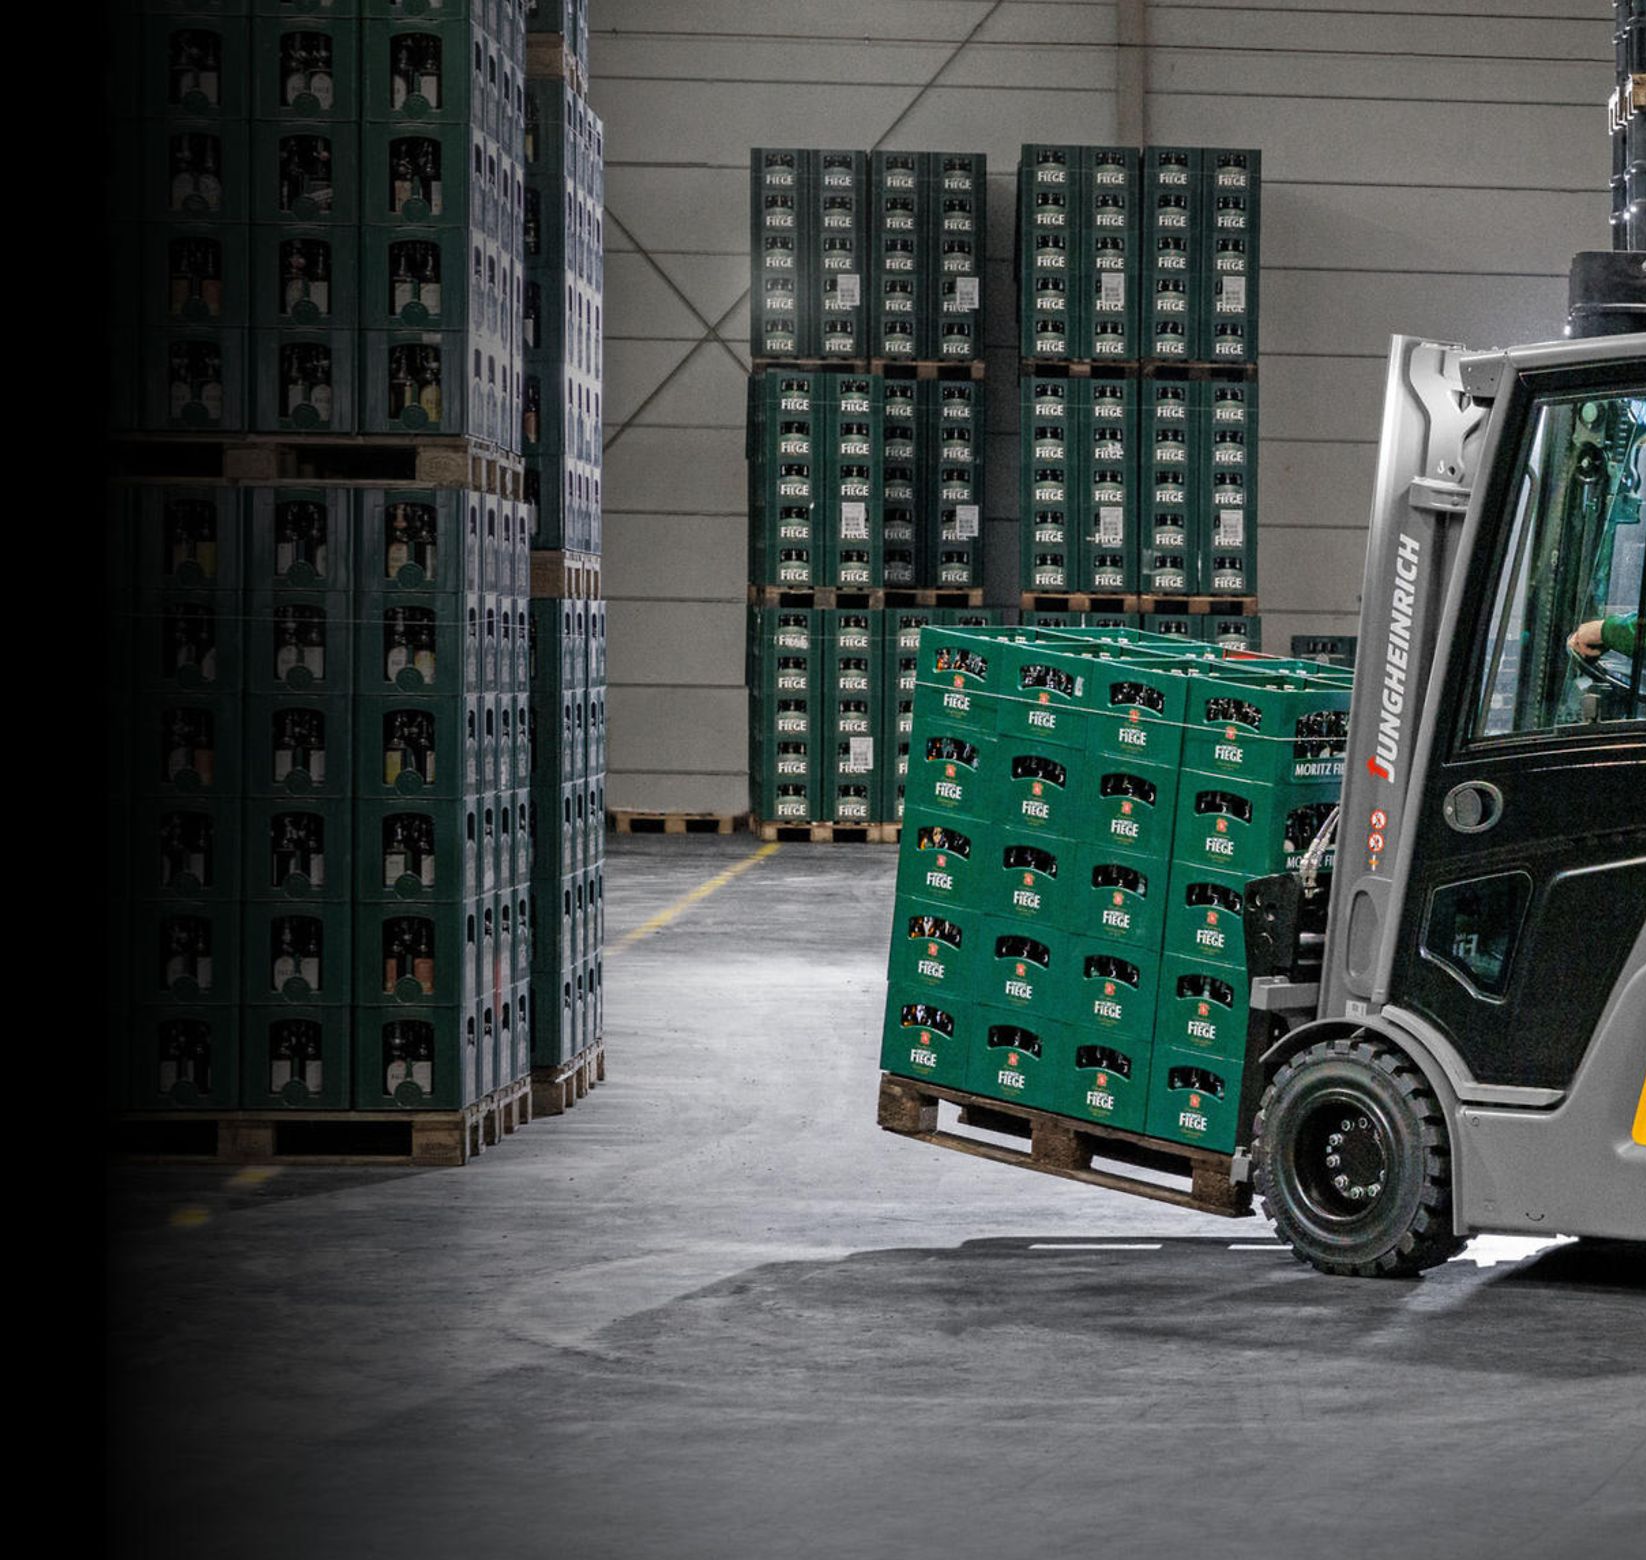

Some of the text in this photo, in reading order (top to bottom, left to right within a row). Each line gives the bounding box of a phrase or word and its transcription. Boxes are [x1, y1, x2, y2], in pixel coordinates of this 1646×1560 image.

[1367, 533, 1420, 783] JUNGHEINRICH
[944, 694, 970, 710] FIEGE
[1029, 711, 1055, 728] FIEGE
[1119, 729, 1146, 745] FIEGE
[1215, 746, 1242, 762] FIEGE
[1295, 763, 1332, 776] MORITZ
[936, 783, 961, 799] FIEGE
[1023, 801, 1048, 818] FIEGE
[1111, 820, 1138, 836] FIEGE
[1206, 838, 1233, 854] FIEGE
[927, 872, 952, 889] FIEGE
[1014, 891, 1040, 908] FIEGE
[1103, 911, 1129, 928] FIEGE
[1197, 930, 1224, 947] FIEGE
[919, 961, 944, 978] FIEGE
[1006, 981, 1032, 998] FIEGE
[1095, 1001, 1121, 1018] FIEGE
[1188, 1021, 1215, 1038] FIEGE
[911, 1049, 936, 1067] FIEGE
[999, 1071, 1024, 1088] FIEGE
[1087, 1092, 1113, 1109] FIEGE
[1180, 1113, 1206, 1130] FIEGE
